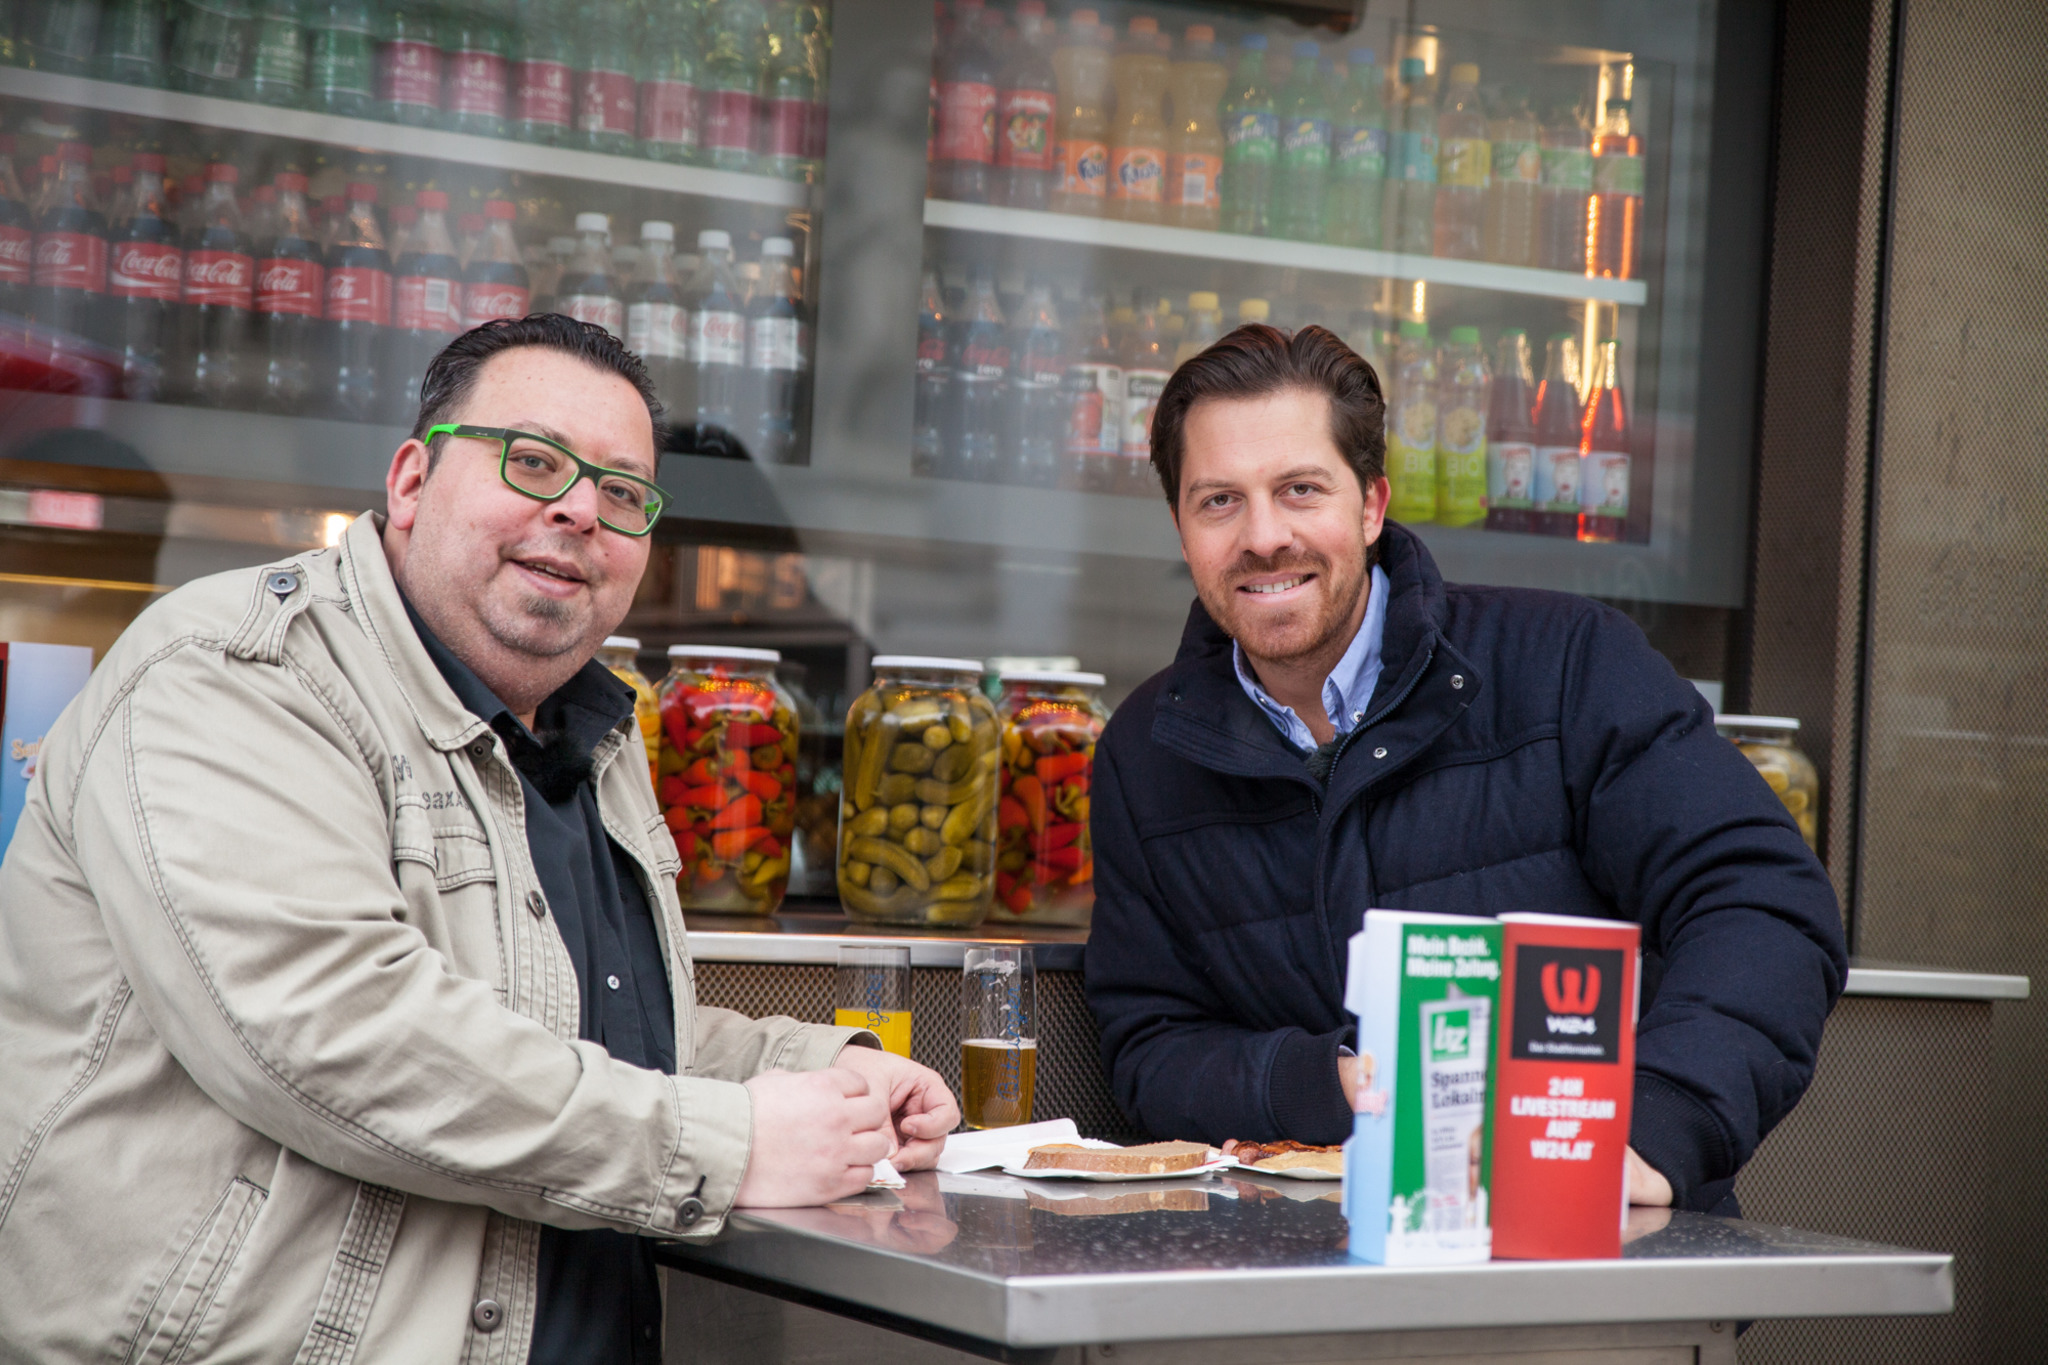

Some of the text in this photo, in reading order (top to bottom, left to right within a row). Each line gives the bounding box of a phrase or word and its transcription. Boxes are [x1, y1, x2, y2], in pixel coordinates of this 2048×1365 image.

[1119, 161, 1162, 187] Fanta
[976, 363, 1005, 377] zero
[1033, 371, 1061, 385] zero
[1446, 455, 1480, 477] BIO
[1406, 934, 1447, 956] Mein
[1406, 957, 1454, 977] Meine
[1546, 1015, 1597, 1034] W24
[1548, 1076, 1584, 1097] 24H
[1510, 1096, 1616, 1120] LIVESTREAM
[1545, 1119, 1582, 1139] AUF
[1530, 1139, 1595, 1160] W24.AT
